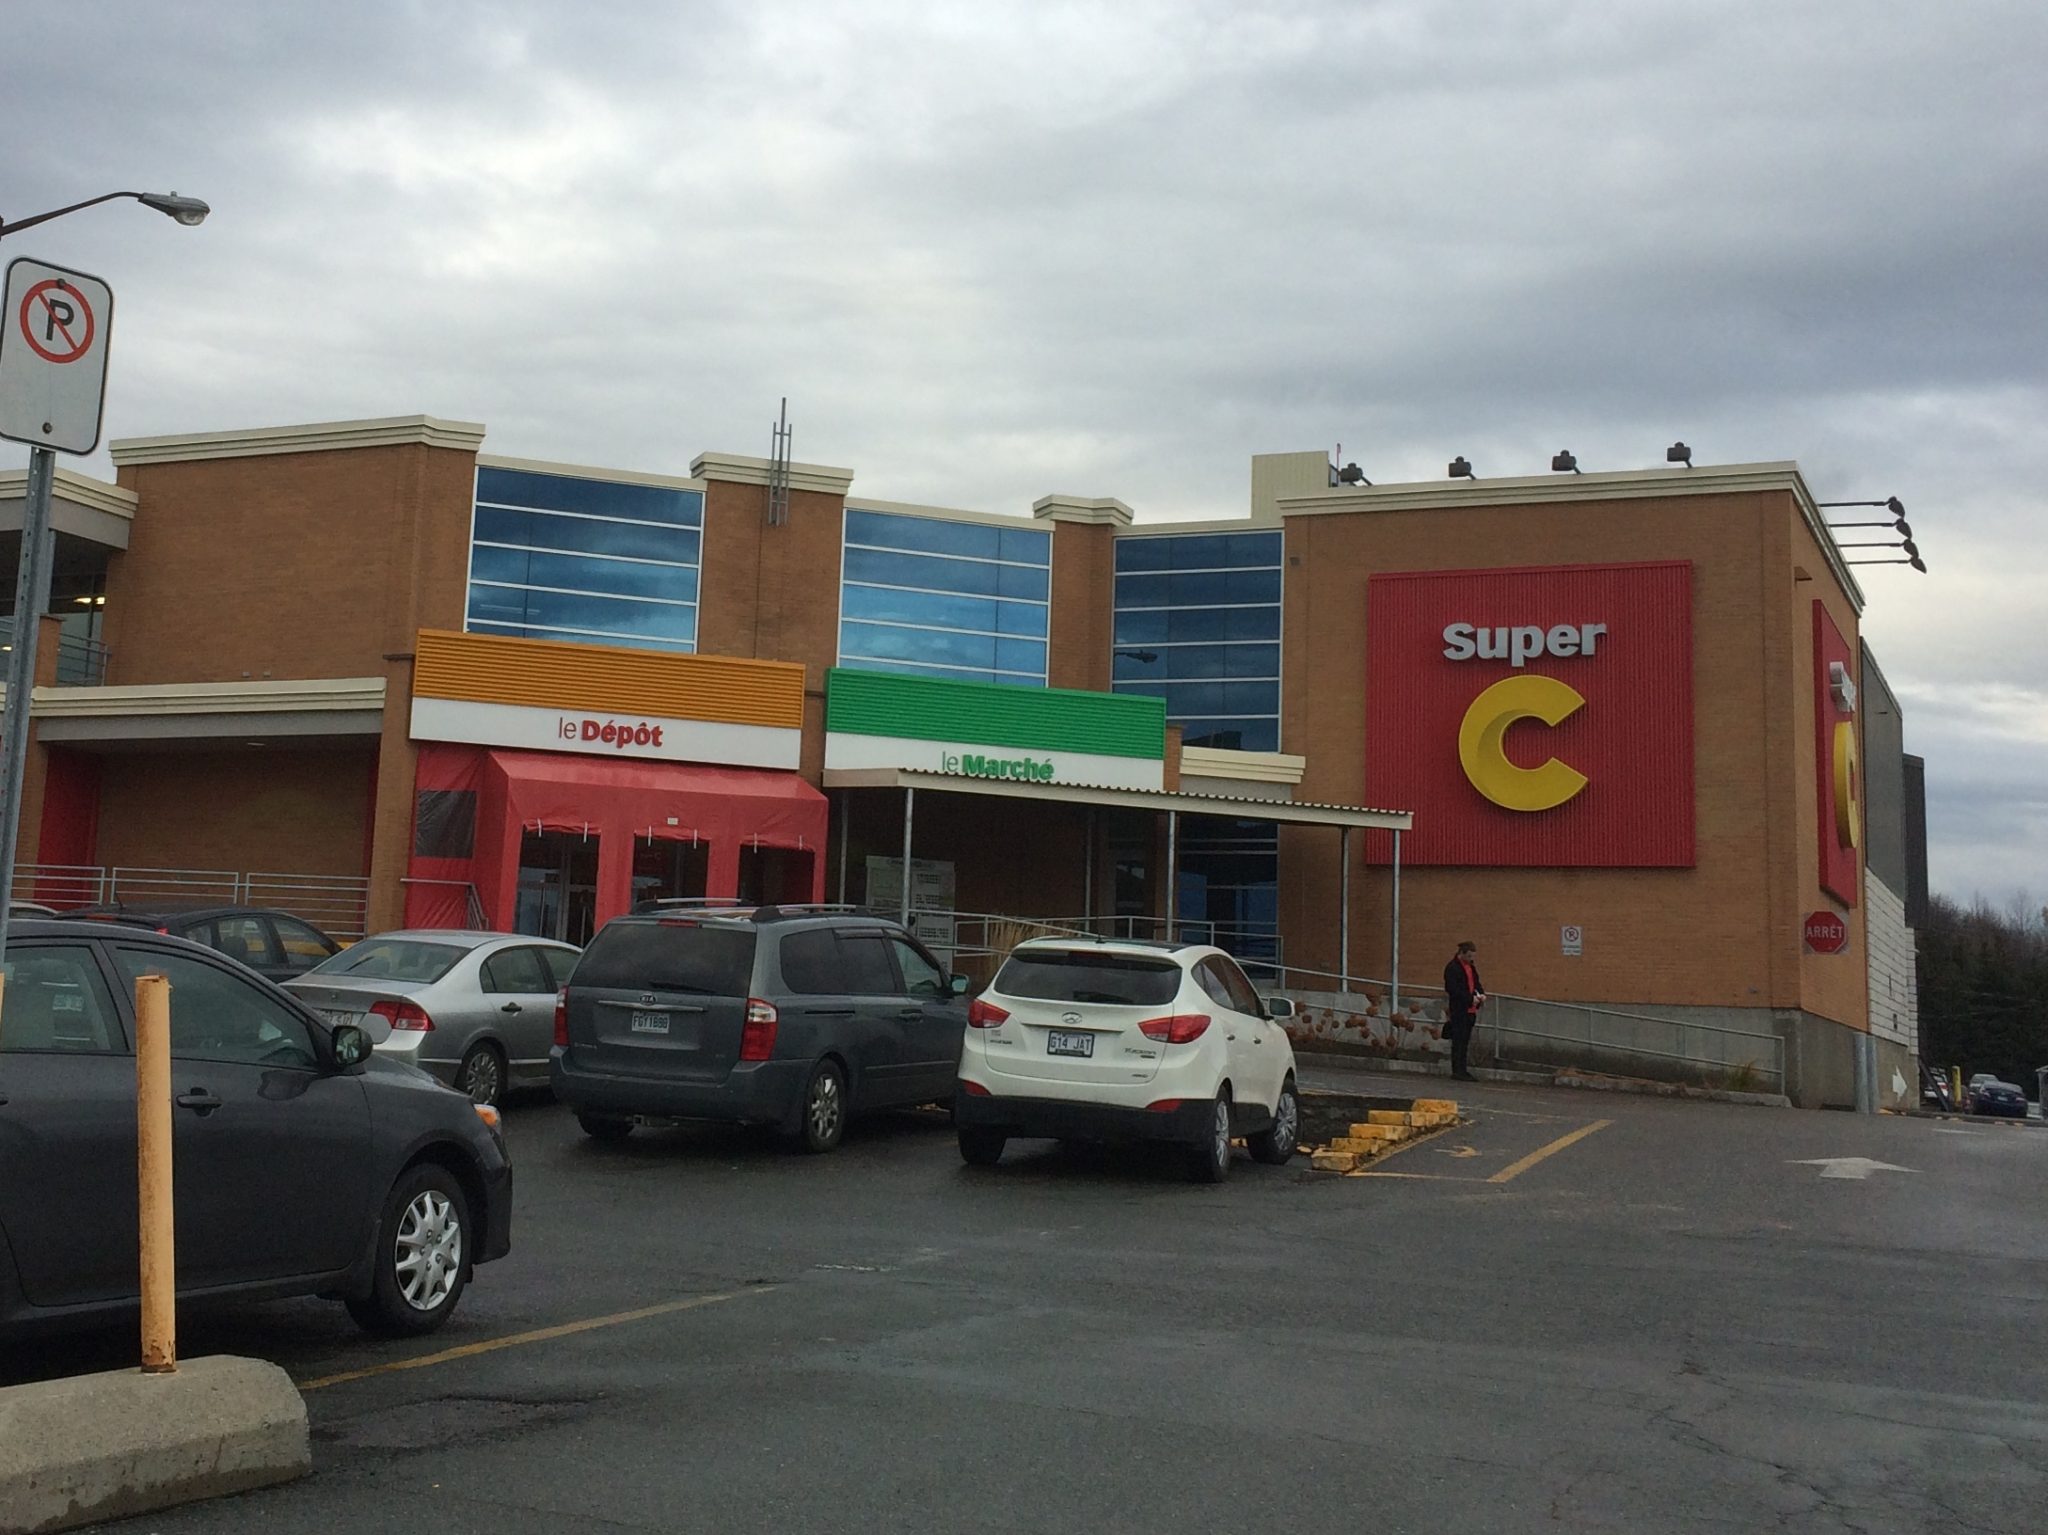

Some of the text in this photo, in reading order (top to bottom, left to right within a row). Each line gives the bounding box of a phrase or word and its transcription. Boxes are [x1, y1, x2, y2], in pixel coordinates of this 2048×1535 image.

[46, 298, 74, 341] P
[1443, 622, 1607, 667] Super
[559, 717, 663, 749] le Dépôt
[1458, 674, 1588, 812] C
[942, 751, 1055, 780] le Marché
[1050, 1035, 1091, 1051] G14 JAT
